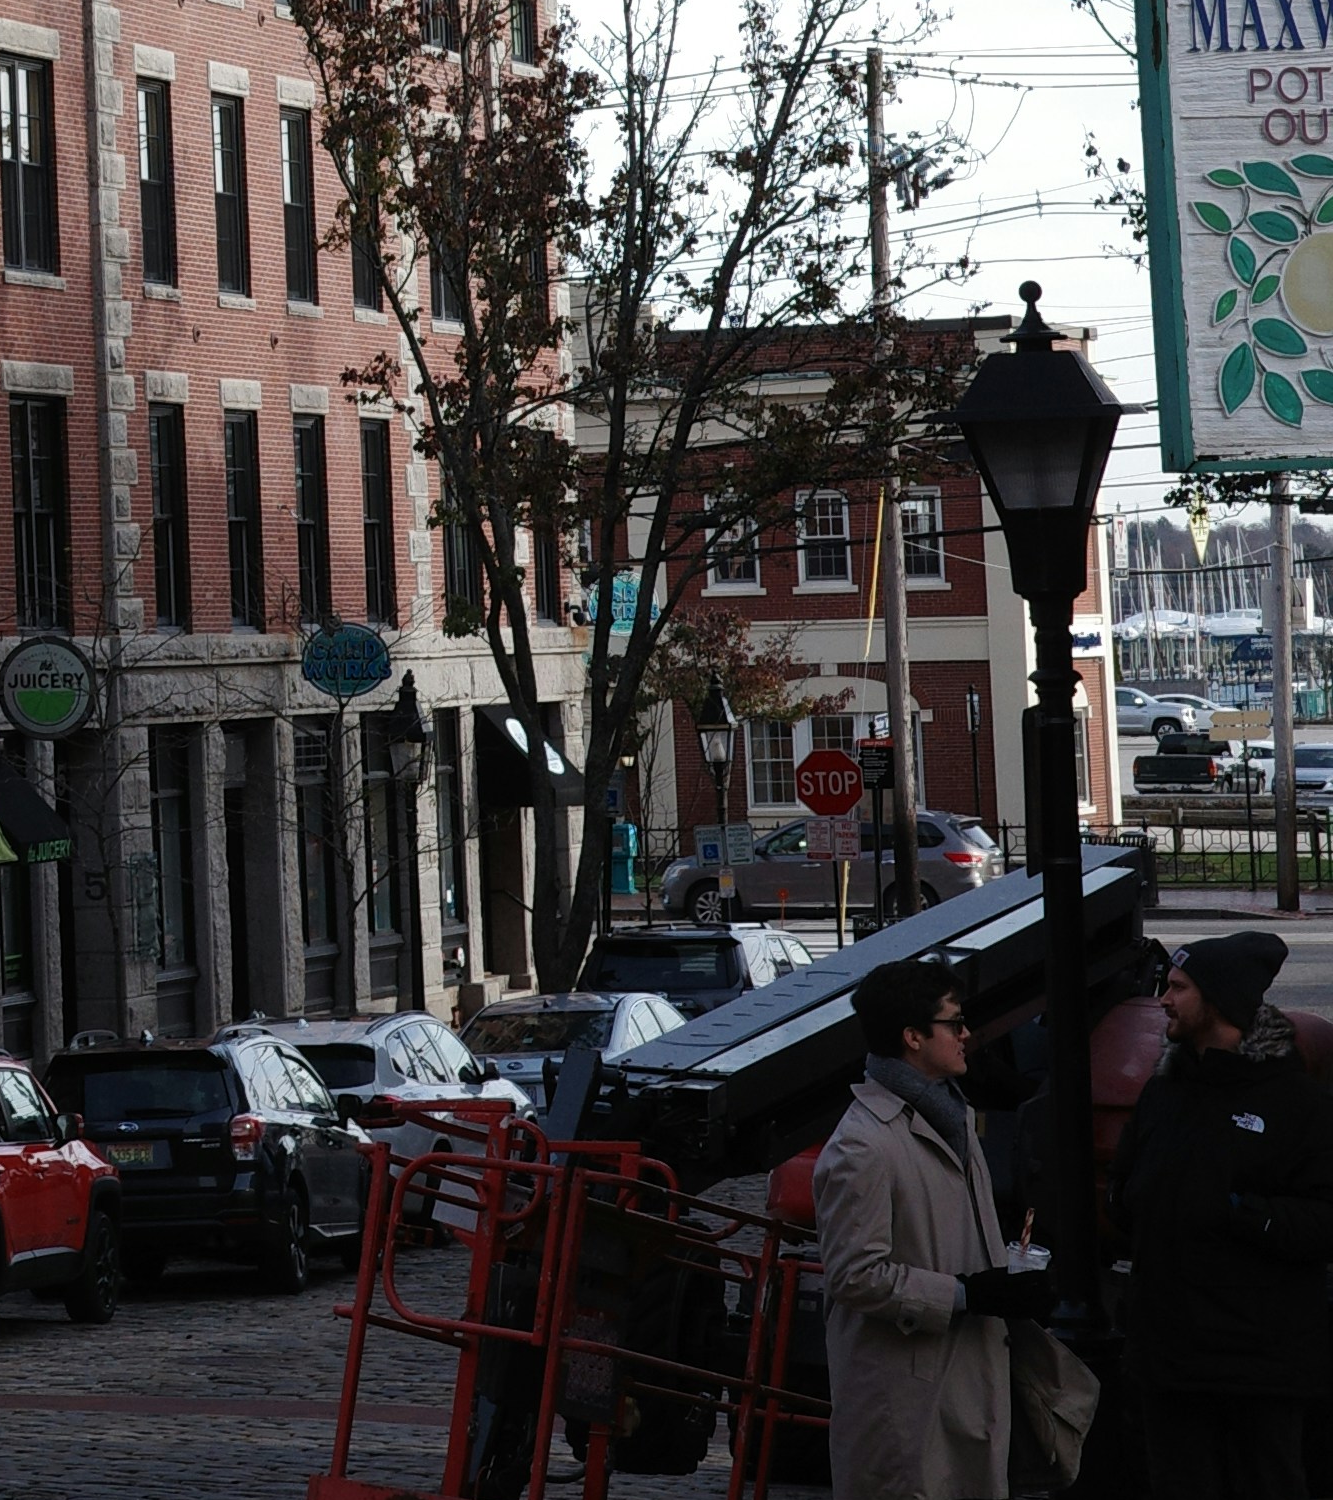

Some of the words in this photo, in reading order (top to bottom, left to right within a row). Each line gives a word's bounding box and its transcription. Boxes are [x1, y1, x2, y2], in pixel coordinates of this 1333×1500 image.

[1263, 107, 1333, 145] OU
[7, 673, 84, 689] JUICERY
[302, 661, 393, 681] WORKS
[800, 770, 858, 797] STOP
[36, 839, 71, 862] JUICERY
